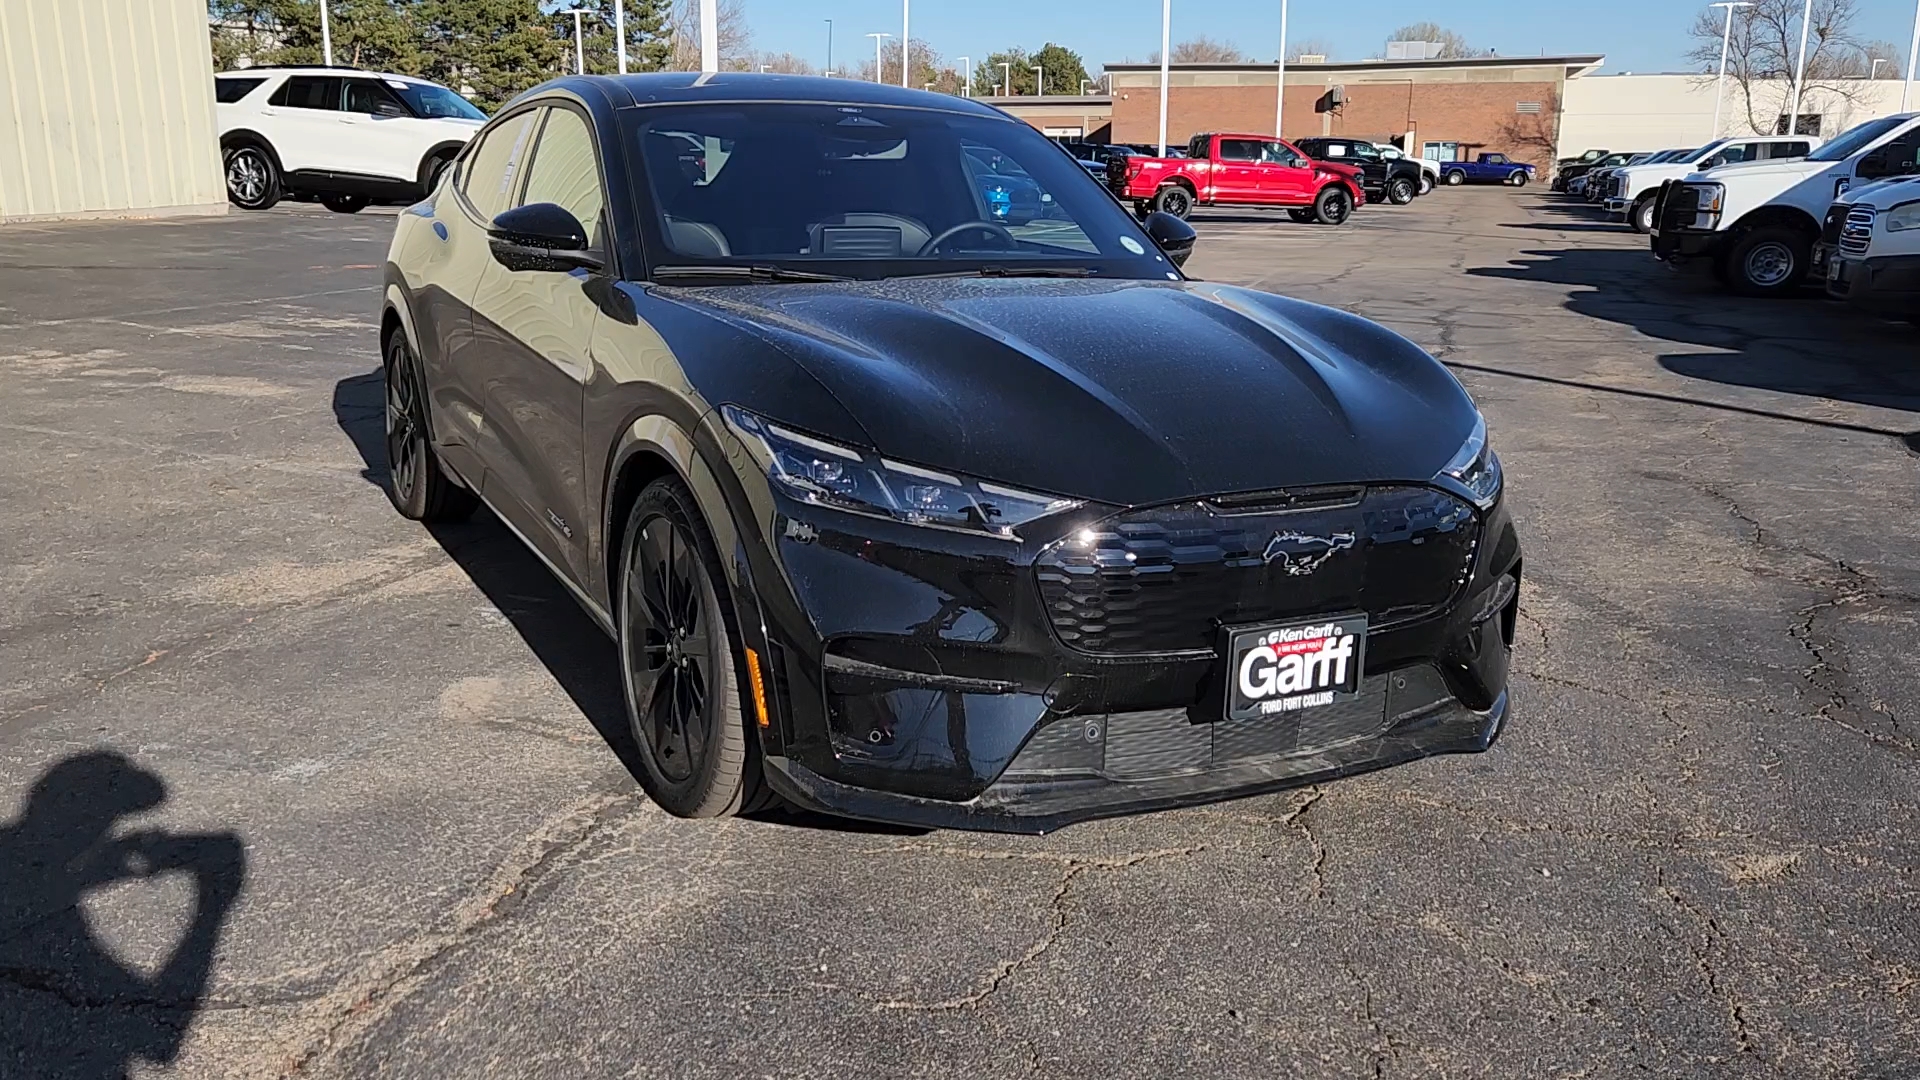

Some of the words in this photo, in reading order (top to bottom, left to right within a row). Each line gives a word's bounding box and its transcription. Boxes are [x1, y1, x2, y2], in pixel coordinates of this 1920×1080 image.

[1278, 628, 1303, 643] Ken
[1304, 623, 1334, 639] Garff
[1239, 634, 1354, 699] Garff
[1261, 699, 1282, 714] FORD
[1283, 696, 1302, 711] FORT
[1302, 691, 1334, 708] COLLINS
